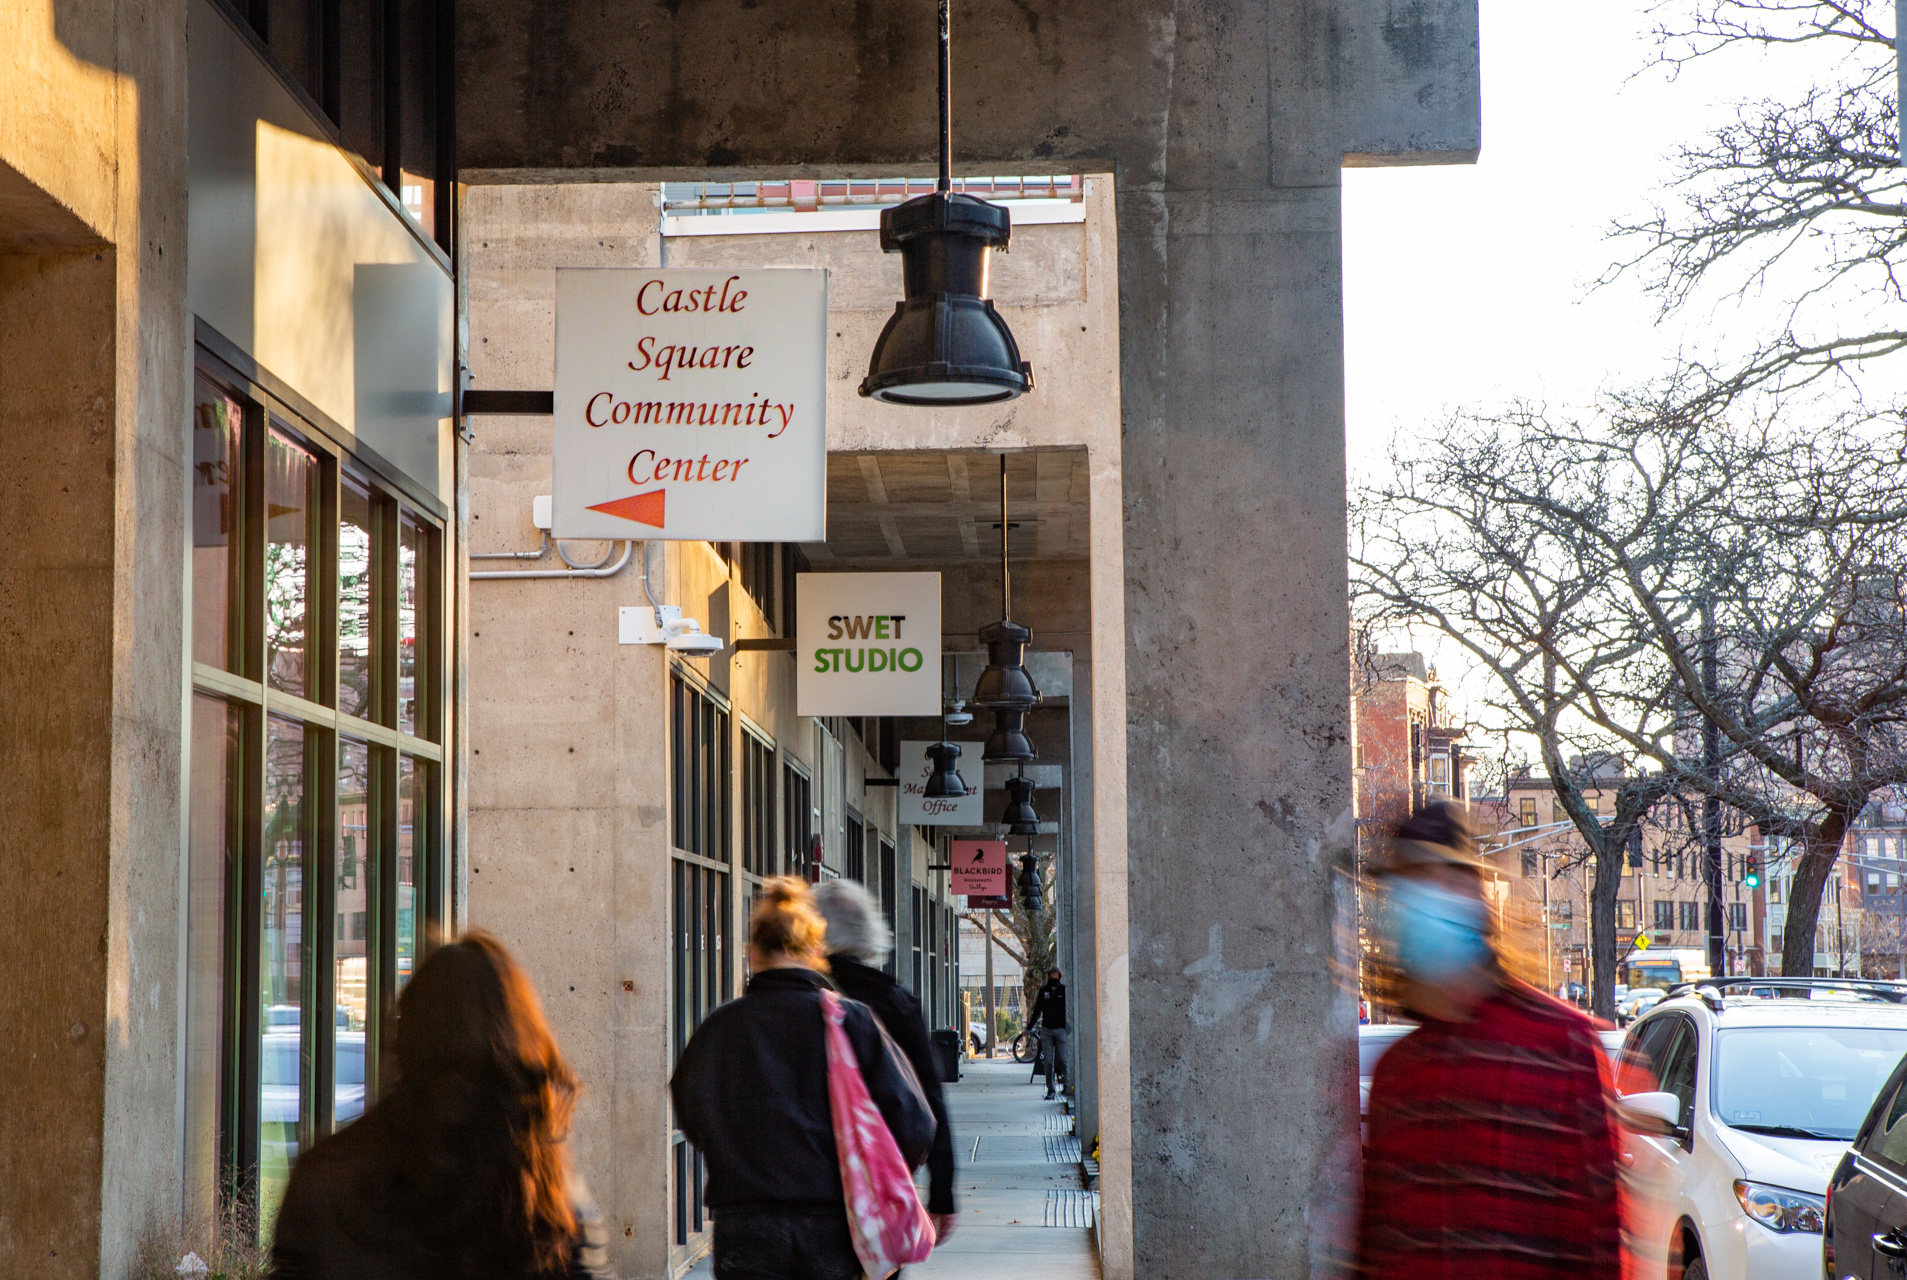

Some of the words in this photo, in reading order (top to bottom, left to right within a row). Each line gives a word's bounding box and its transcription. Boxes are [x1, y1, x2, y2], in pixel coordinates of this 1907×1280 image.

[636, 275, 748, 316] Castle
[627, 336, 755, 381] Square
[585, 391, 795, 439] Community
[627, 449, 749, 485] Center
[827, 615, 906, 641] SWET
[813, 647, 924, 673] STUDIO
[922, 799, 958, 816] Office
[953, 867, 1003, 875] BLACKBIRD
